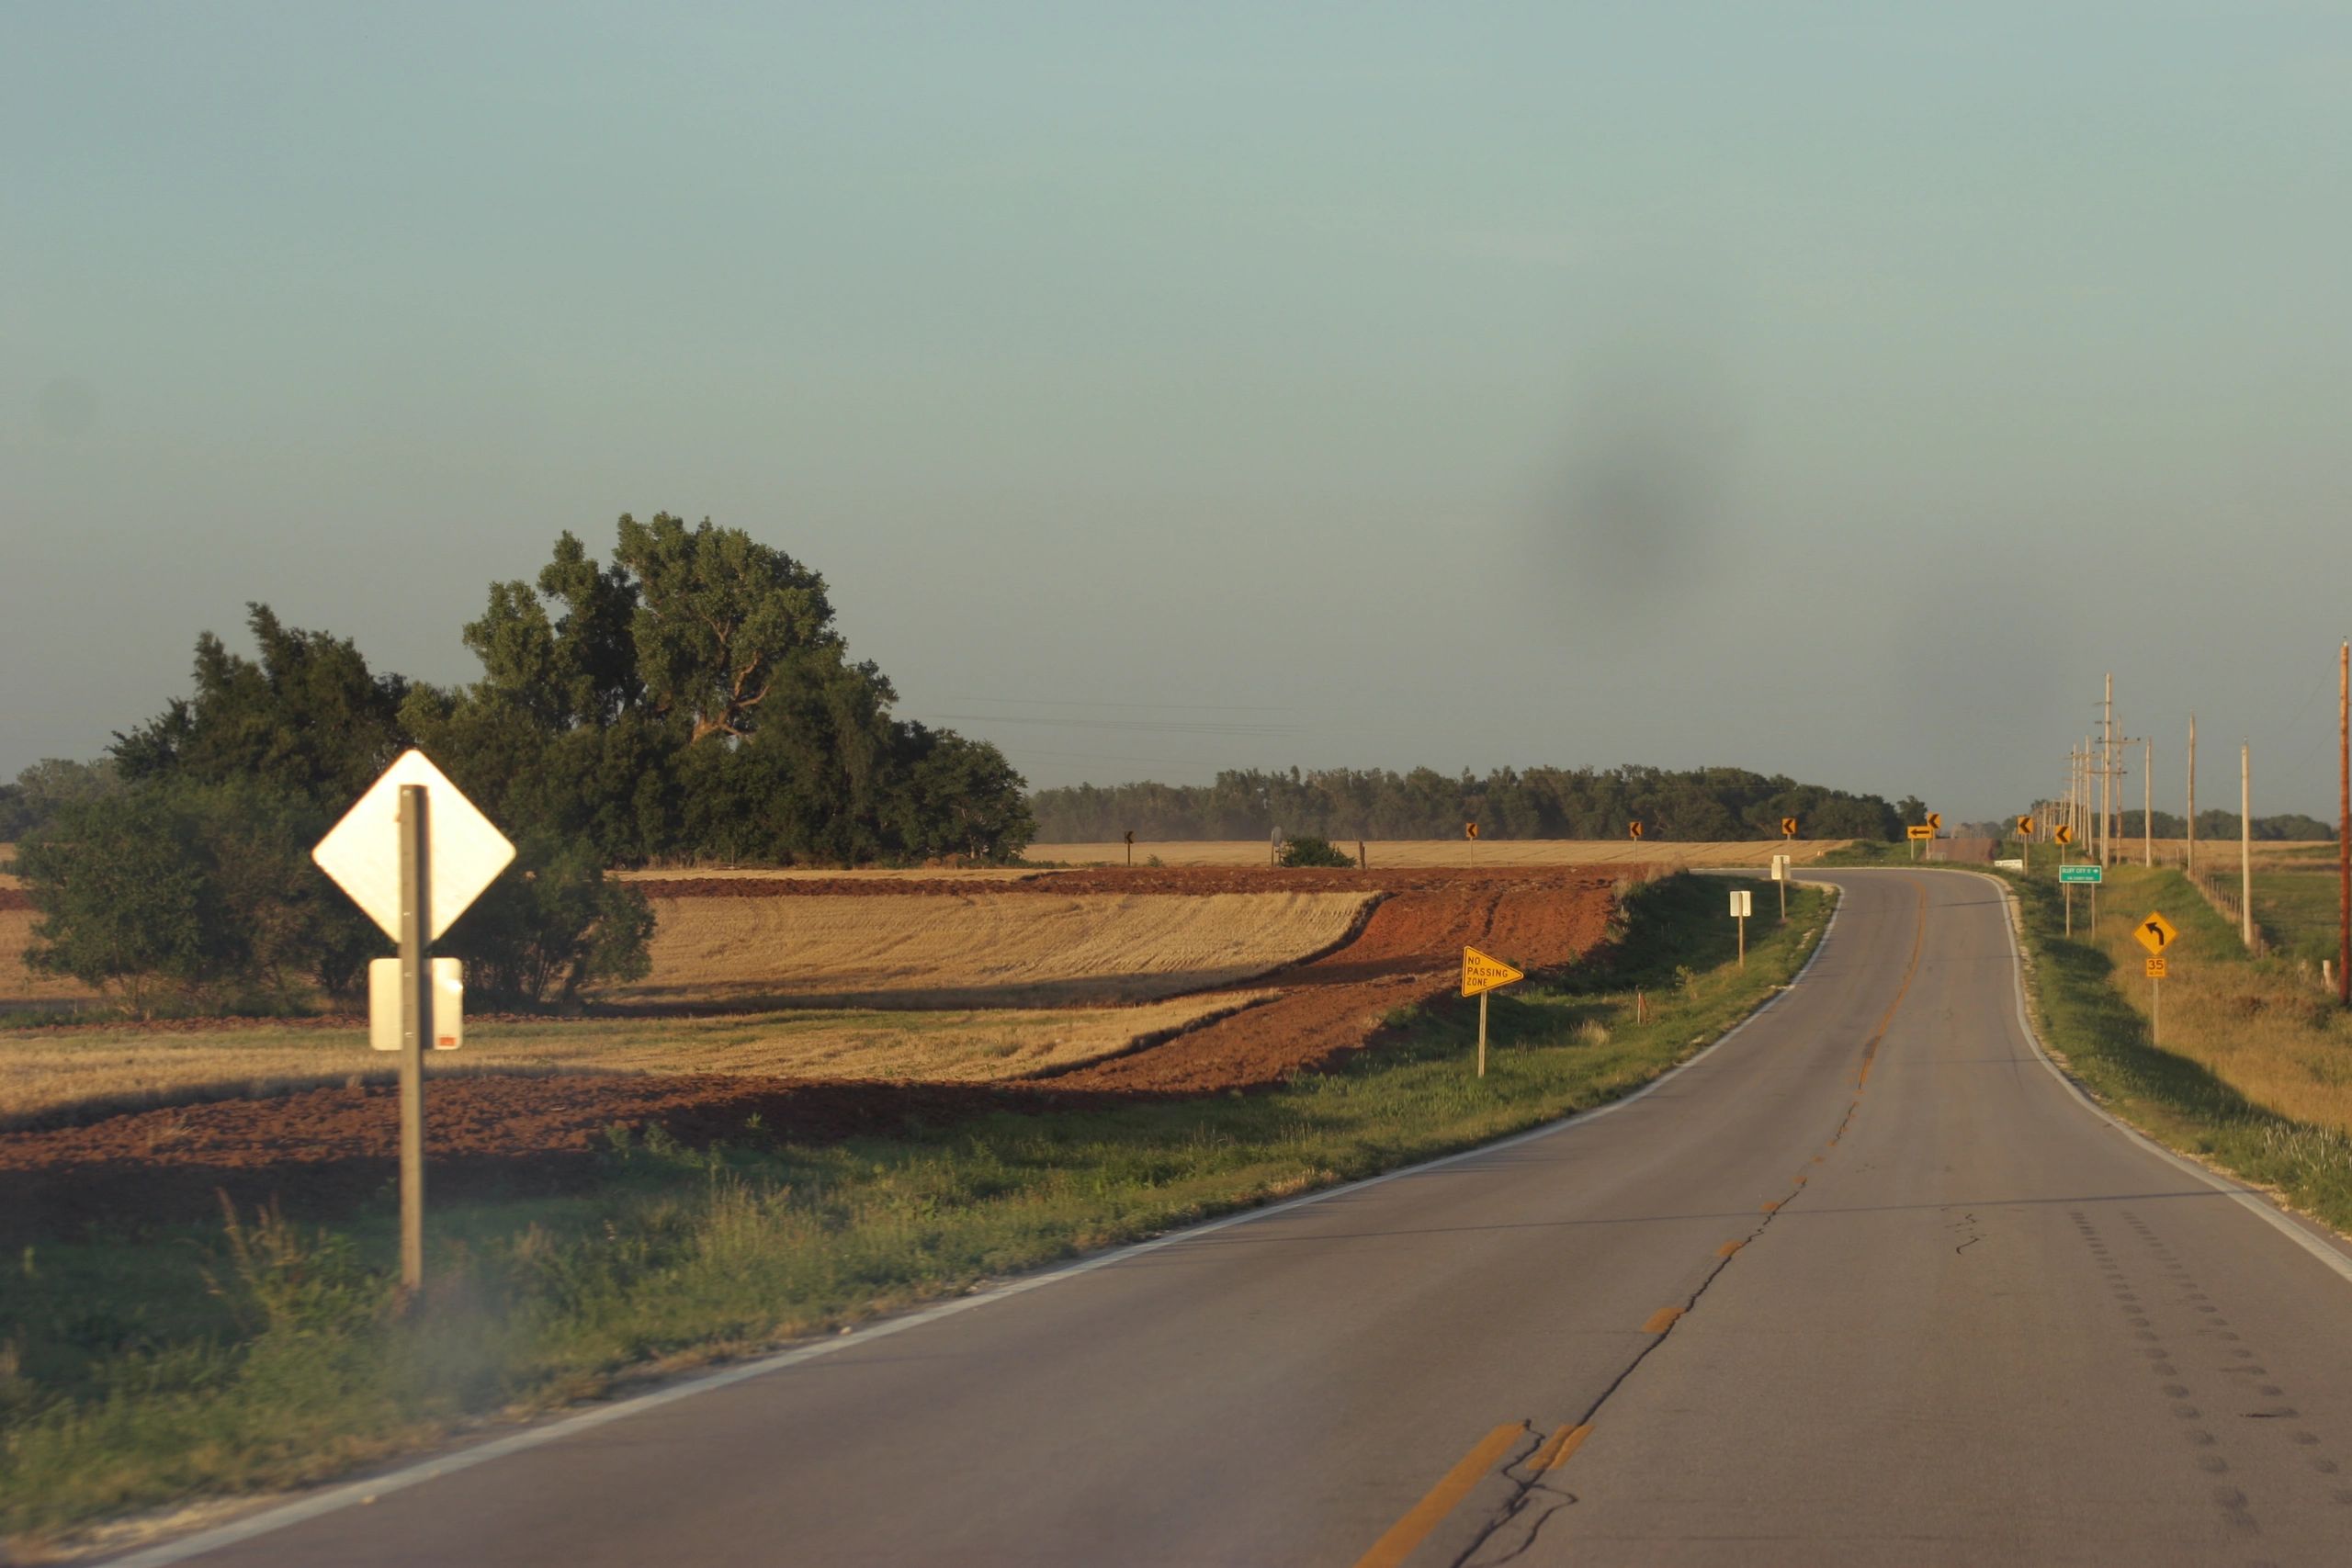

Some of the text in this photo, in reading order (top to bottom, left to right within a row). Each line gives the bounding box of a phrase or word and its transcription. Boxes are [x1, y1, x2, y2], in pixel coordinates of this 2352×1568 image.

[1468, 956, 1480, 965] NO
[2148, 959, 2163, 970] 35
[1467, 966, 1508, 977] PASSING
[1466, 977, 1487, 987] ZONE
